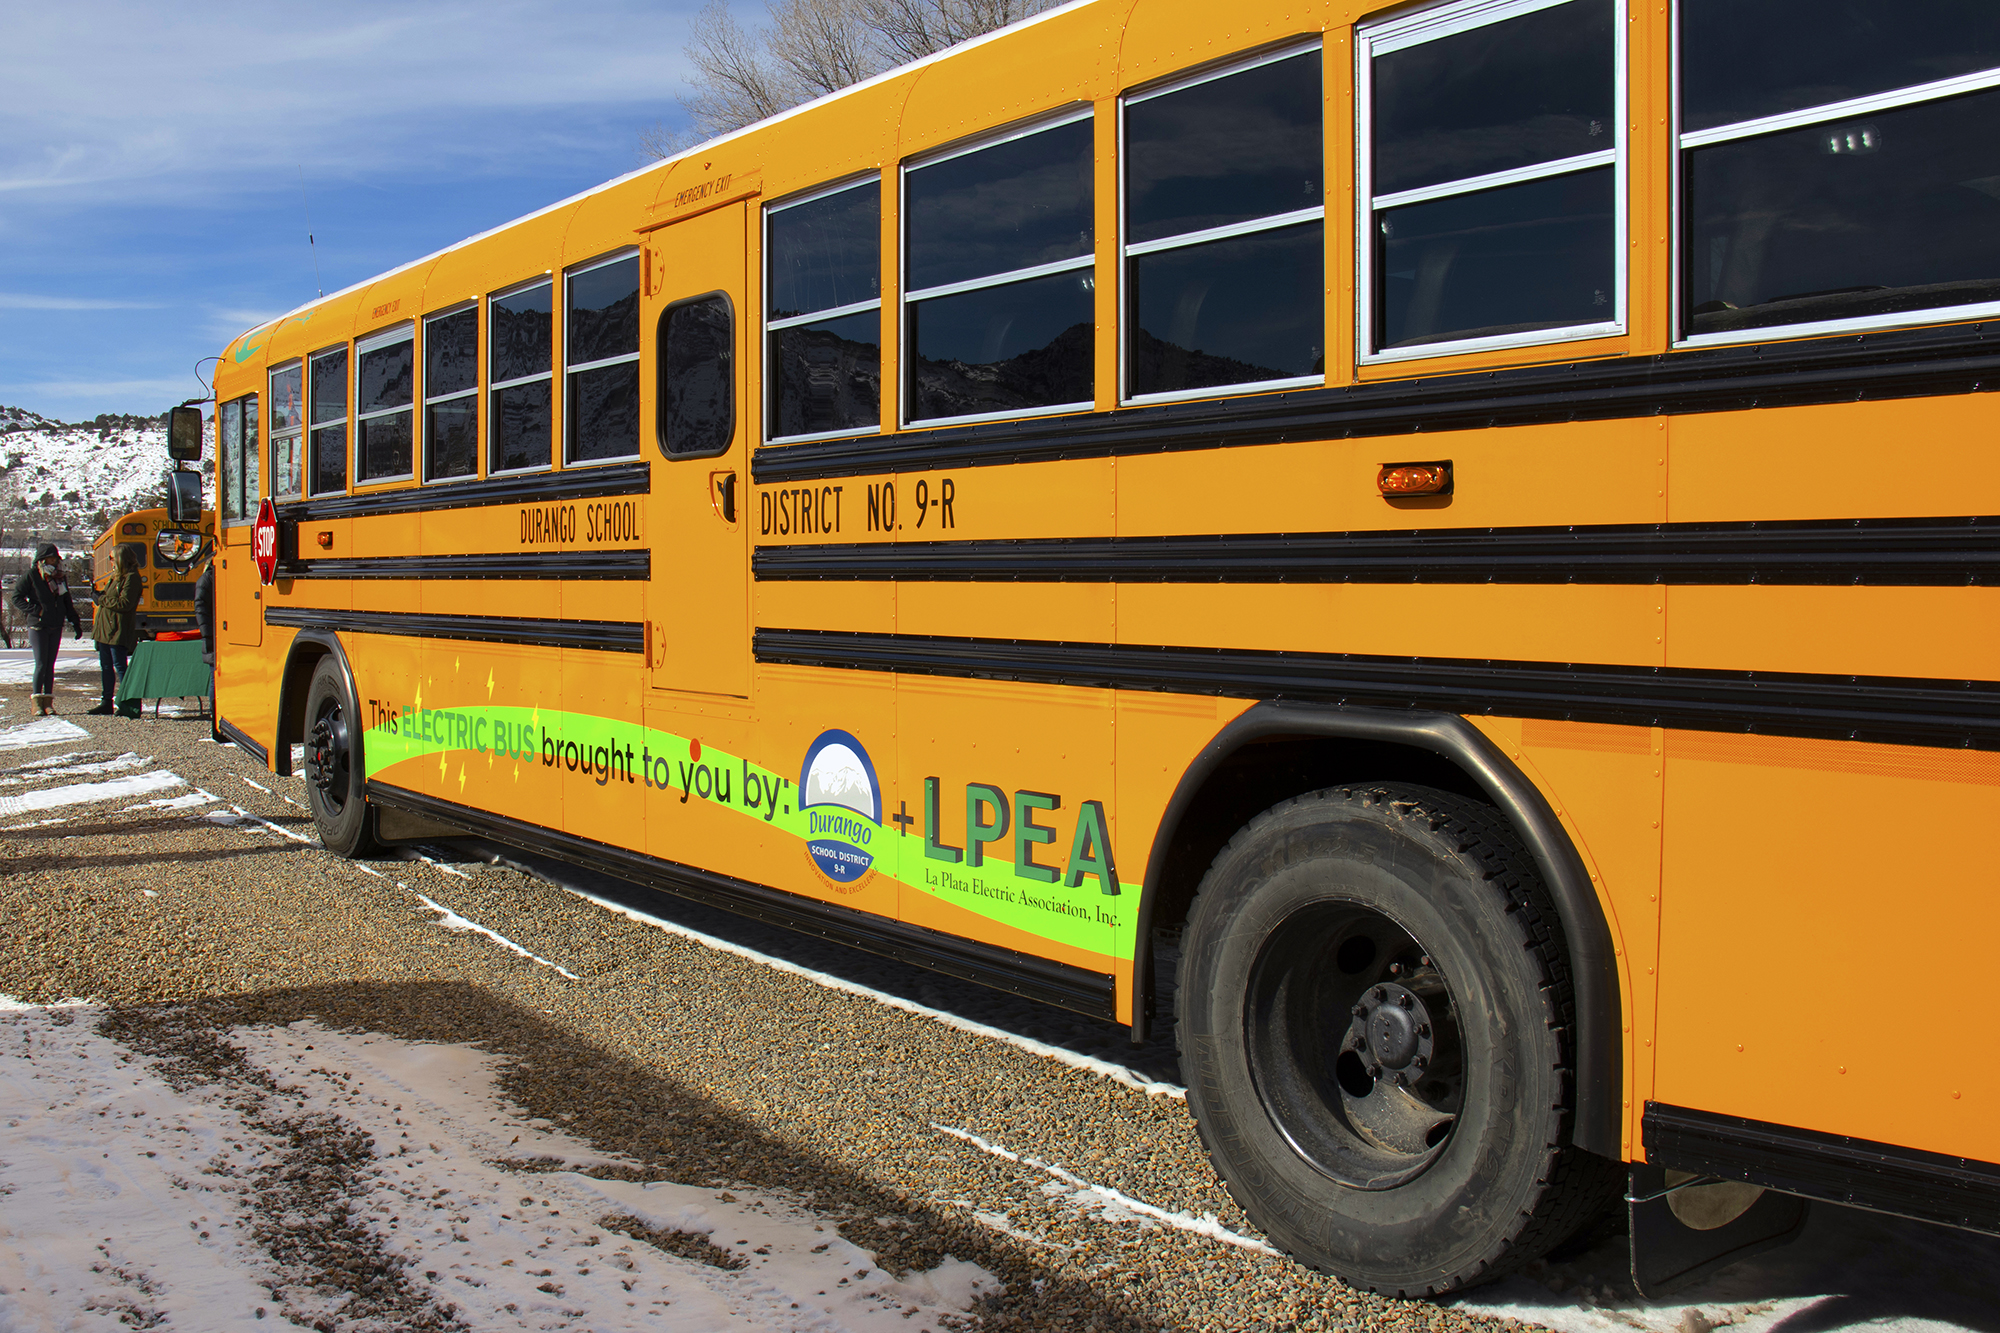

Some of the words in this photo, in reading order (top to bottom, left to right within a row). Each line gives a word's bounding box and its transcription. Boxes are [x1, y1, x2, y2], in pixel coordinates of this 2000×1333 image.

[674, 180, 715, 208] EMERGENCY
[715, 173, 732, 194] EXIT
[153, 519, 179, 531] SCHOO
[520, 505, 576, 544] DURANGO
[586, 501, 640, 542] SCHOOL
[761, 486, 843, 536] DISTRICT
[867, 481, 903, 532] NO.
[915, 478, 955, 529] 9-R
[258, 525, 275, 557] STOP
[368, 699, 398, 734] This
[402, 705, 487, 753] ELECTRIC
[494, 718, 535, 763] BUS
[542, 726, 635, 786] brought
[642, 747, 670, 790] to
[678, 760, 731, 804] you
[742, 759, 790, 822] by:
[809, 811, 872, 845] Durango
[924, 776, 1121, 896] LPEA
[804, 851, 834, 890] INNOVATION
[835, 886, 848, 895] AND
[848, 865, 879, 895] EXCELLENCE
[811, 845, 838, 860] SCHOOL
[839, 851, 869, 867] DISTRICT
[834, 863, 846, 875] 9-R
[925, 868, 938, 886] La
[941, 871, 969, 893] Plata
[972, 878, 1016, 903] Electric
[1018, 889, 1091, 923] Association,
[1095, 905, 1121, 927] Inc.
[1193, 1033, 1307, 1228] MICHELIN
